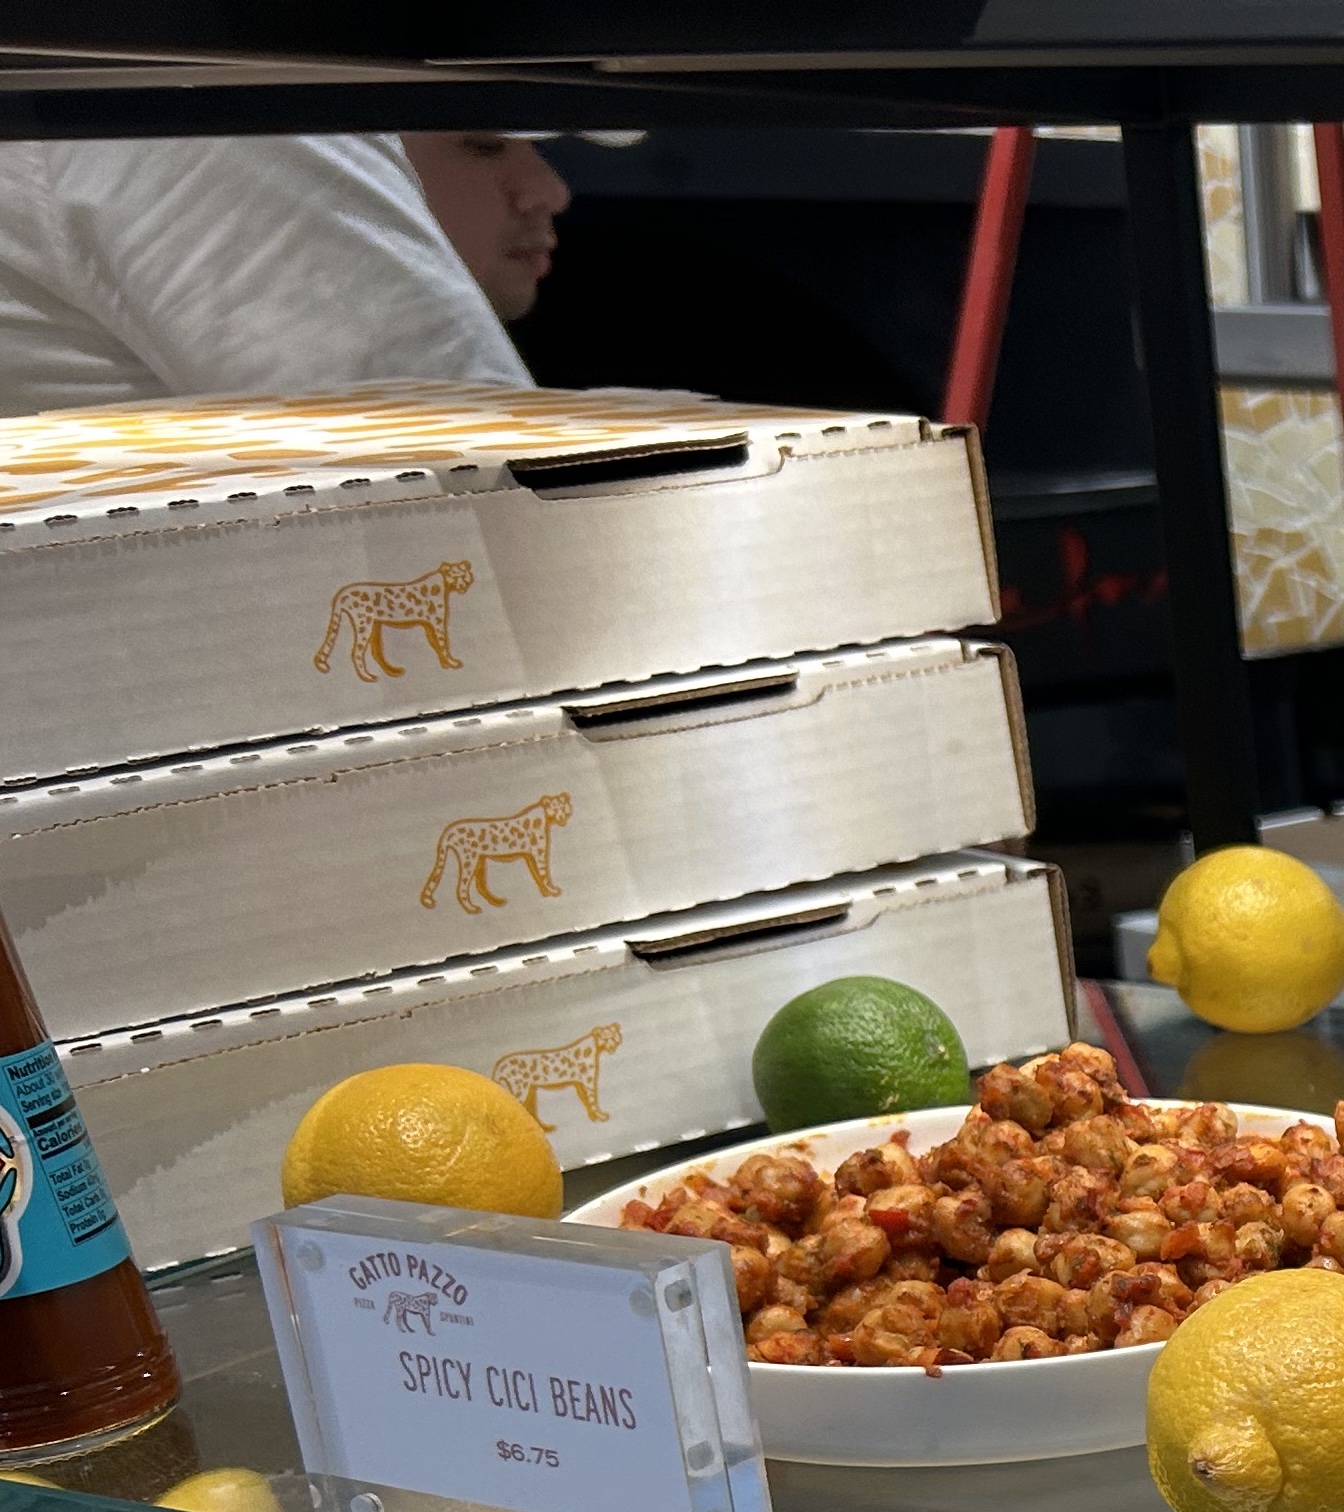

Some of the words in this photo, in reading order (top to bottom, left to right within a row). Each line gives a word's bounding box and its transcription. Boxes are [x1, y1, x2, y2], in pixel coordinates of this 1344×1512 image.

[49, 1167, 72, 1185] Total
[62, 1200, 85, 1217] Total
[348, 1252, 401, 1290] GATTO
[406, 1254, 468, 1306] PAZZO
[400, 1350, 472, 1401] SPICY
[486, 1365, 539, 1413] CICI
[550, 1376, 637, 1430] BEANS
[496, 1438, 560, 1468] $6.75
